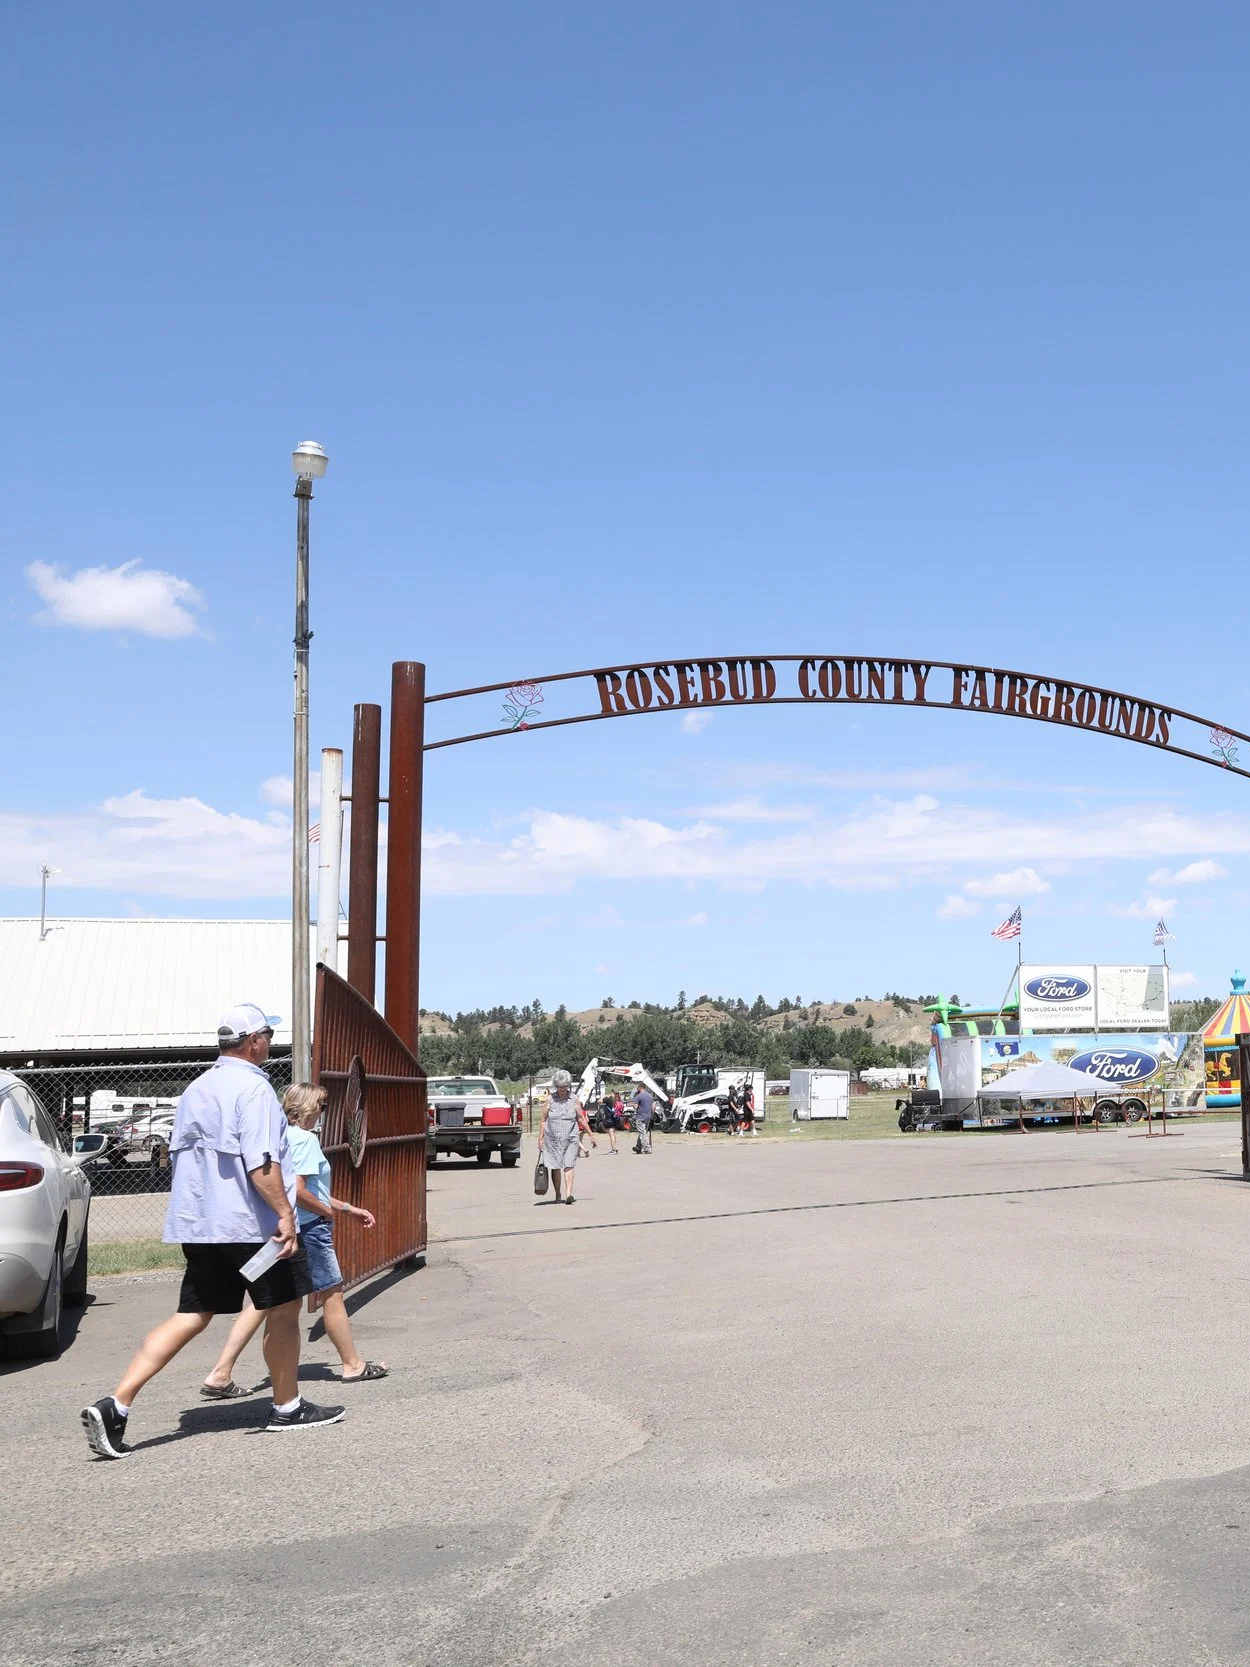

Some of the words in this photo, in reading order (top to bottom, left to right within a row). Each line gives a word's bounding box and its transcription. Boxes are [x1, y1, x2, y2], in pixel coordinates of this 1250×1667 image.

[594, 660, 777, 713] ROSEBUD
[798, 659, 931, 702] COUNTY
[951, 667, 1172, 745] FAIRGROUNDS
[1037, 978, 1078, 997] Ford
[1086, 1052, 1141, 1078] Ford
